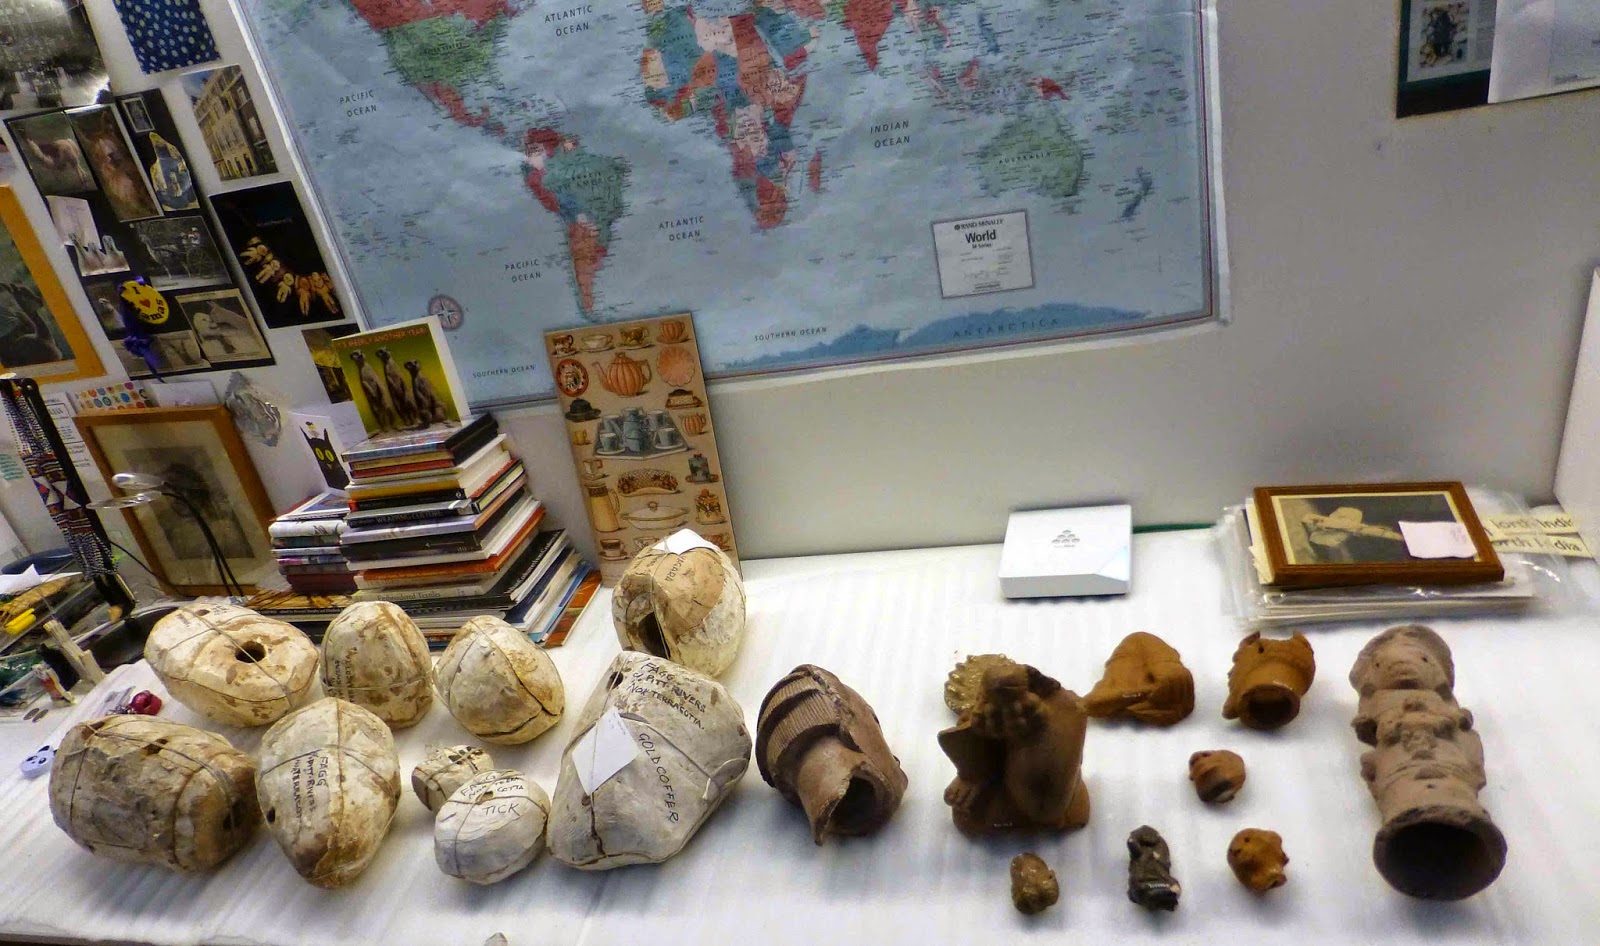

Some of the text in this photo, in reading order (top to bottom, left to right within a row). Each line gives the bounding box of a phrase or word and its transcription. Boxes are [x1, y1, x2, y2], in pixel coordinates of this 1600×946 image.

[545, 5, 593, 24] ATLANTIC
[555, 22, 589, 37] OCEAN
[339, 90, 375, 104] PACIFIC
[346, 104, 377, 118] OCEAN
[869, 120, 910, 135] INDIAN
[874, 134, 911, 149] OCEAN
[658, 215, 704, 230] ATLANTIC
[669, 230, 701, 241] OCEAN
[965, 229, 997, 243] World
[505, 259, 539, 271] PACIFIC
[511, 271, 542, 283] OCEAN
[132, 286, 141, 295] I
[754, 326, 828, 342] SOUTHERN OCEAN
[473, 364, 535, 379] SOUTHERN OCEAN
[482, 803, 521, 817] TICK
